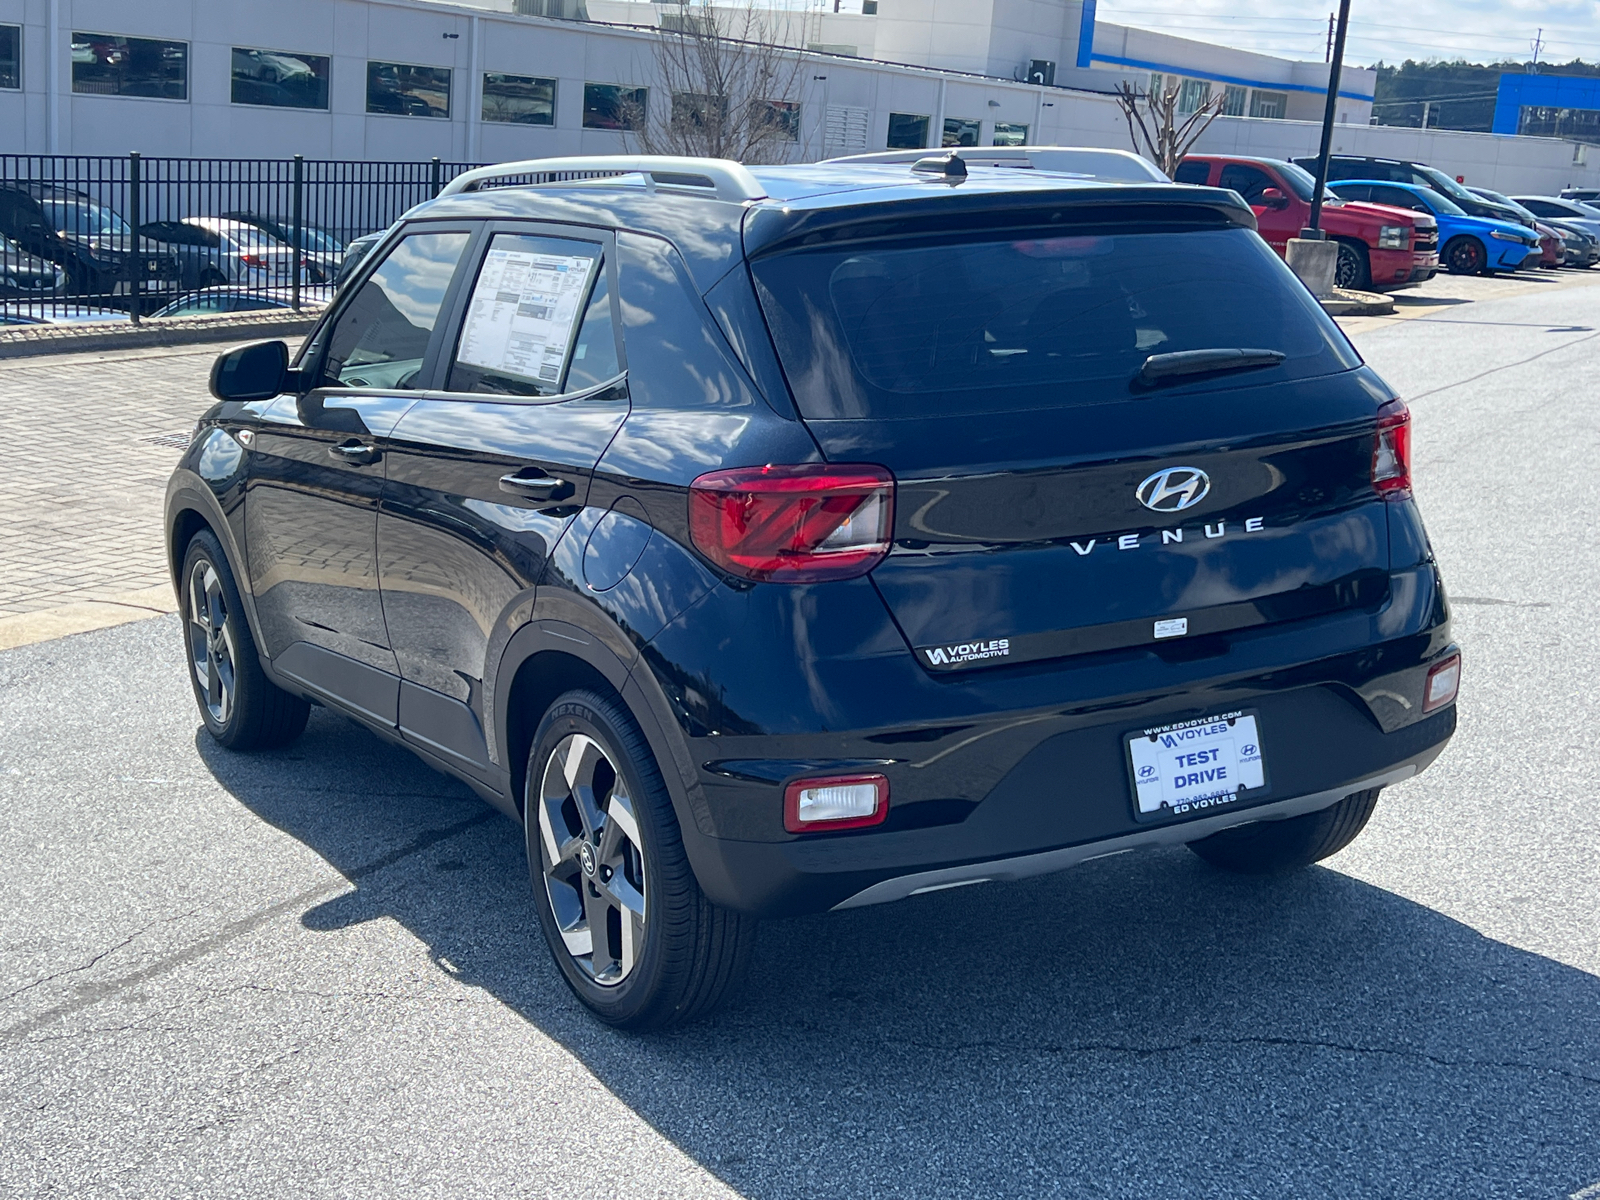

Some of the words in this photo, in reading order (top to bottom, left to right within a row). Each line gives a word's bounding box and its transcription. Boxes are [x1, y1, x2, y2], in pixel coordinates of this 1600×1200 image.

[1069, 516, 1264, 556] VENUE
[947, 639, 1009, 655] VOYLES
[950, 648, 1009, 663] AUTOMOTIVE
[551, 704, 593, 720] NEXEN
[1143, 711, 1242, 735] WWW.EDVOYLES.COM
[1176, 723, 1228, 741] VOYLES
[1175, 748, 1219, 768] TEST
[1174, 766, 1227, 789] DRIVE
[1173, 804, 1190, 815] ED
[1191, 793, 1237, 810] VOYLES
